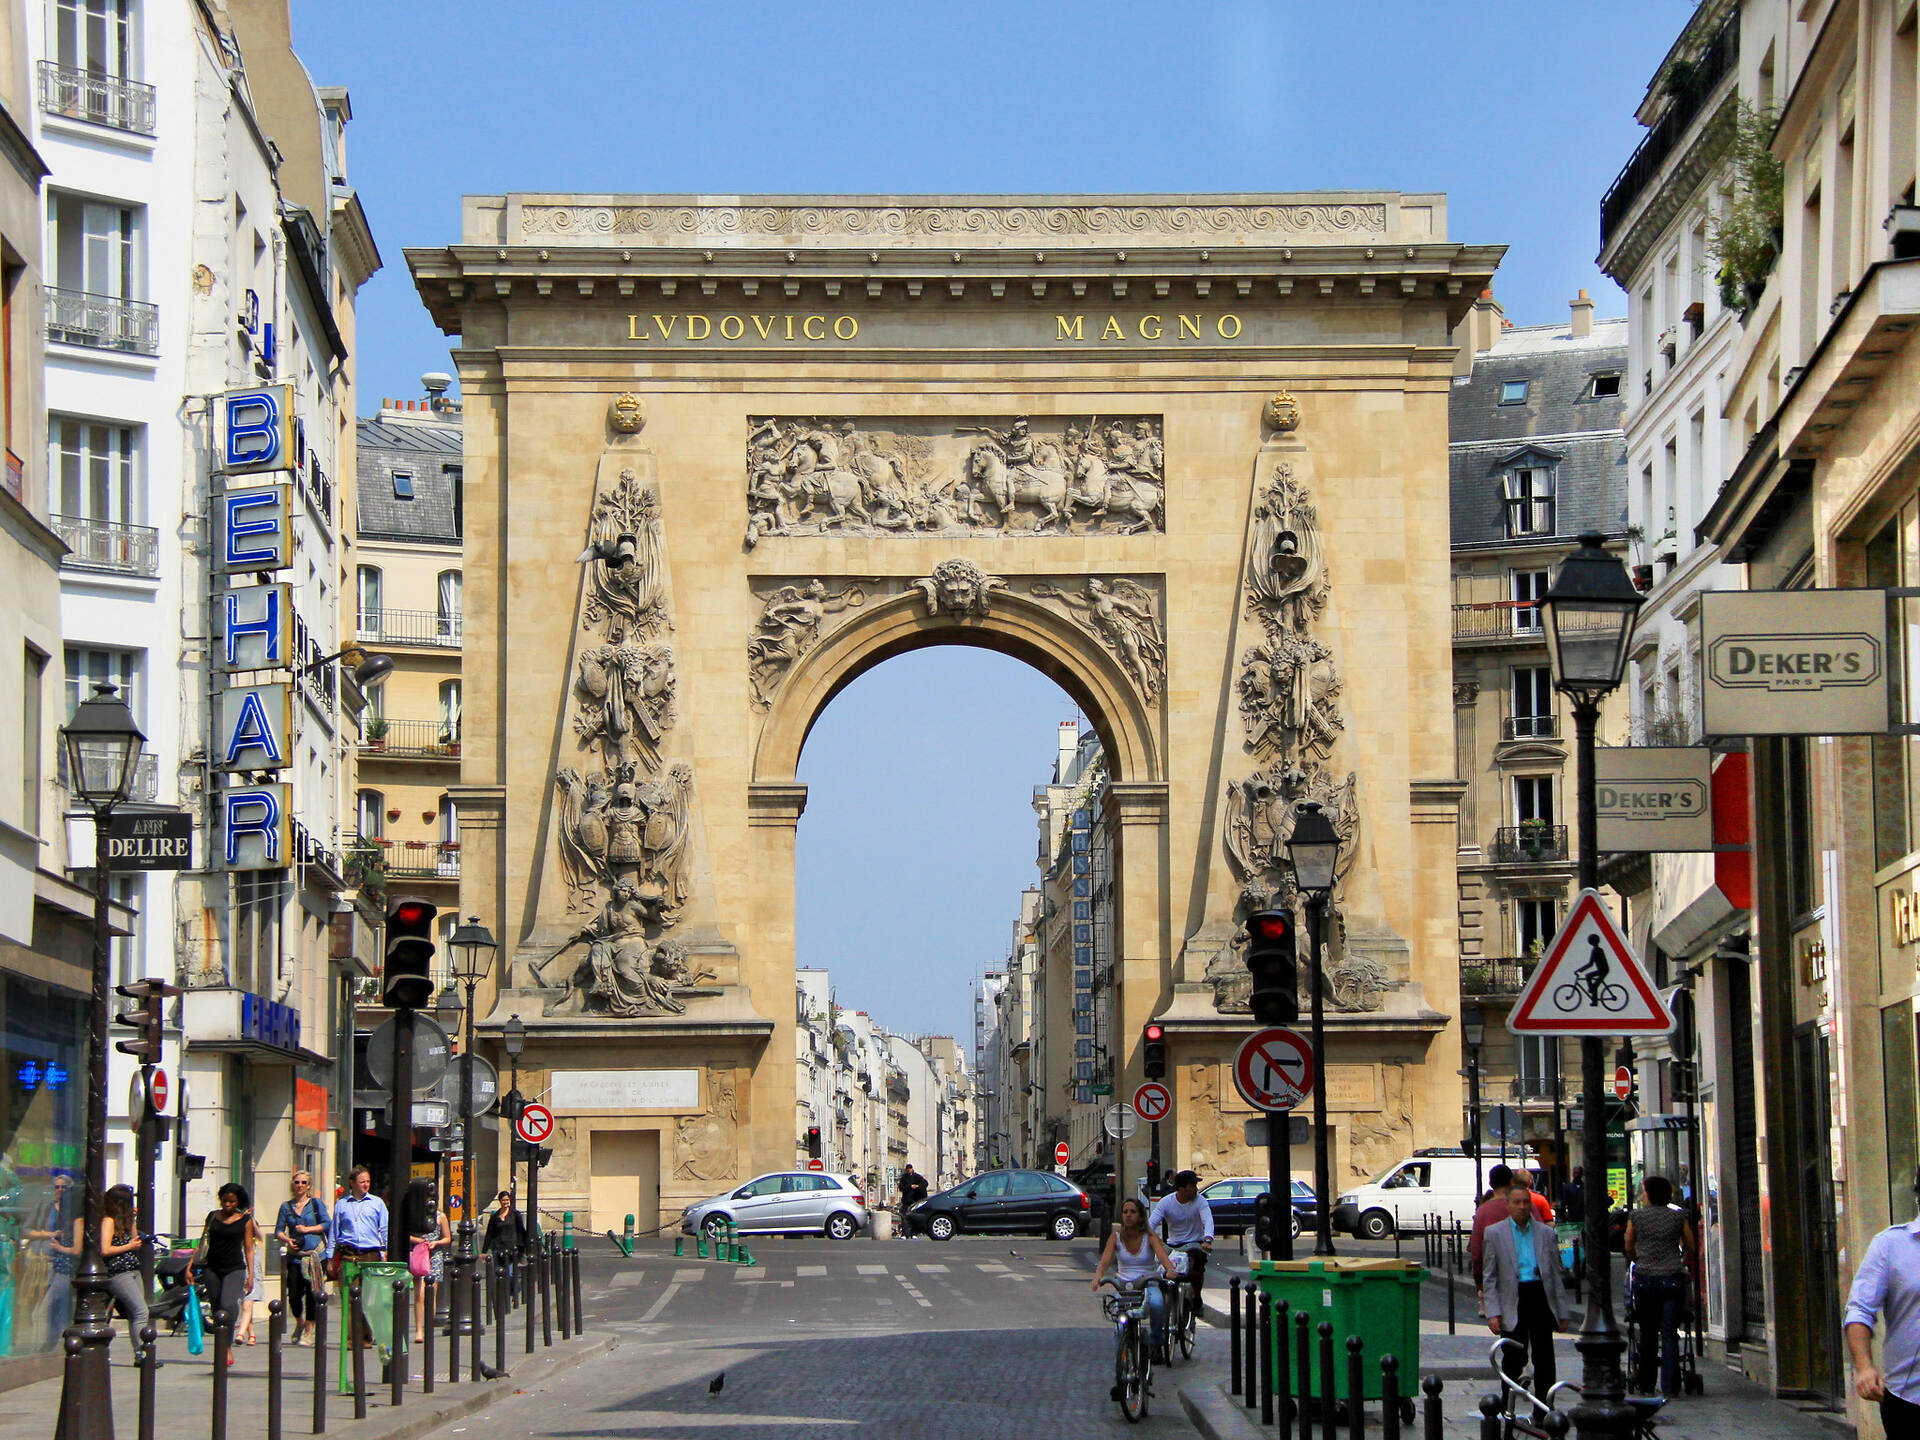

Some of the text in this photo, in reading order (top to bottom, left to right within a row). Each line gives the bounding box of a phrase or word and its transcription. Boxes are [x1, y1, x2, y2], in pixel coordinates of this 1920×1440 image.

[627, 313, 1244, 342] LVDOVICO MAGNO
[224, 393, 282, 864] BEHAR
[1729, 646, 1860, 675] DEKER'S
[1598, 787, 1692, 808] DEKER'S
[108, 838, 188, 857] DELIRE
[1074, 812, 1090, 965] PASSAGE
